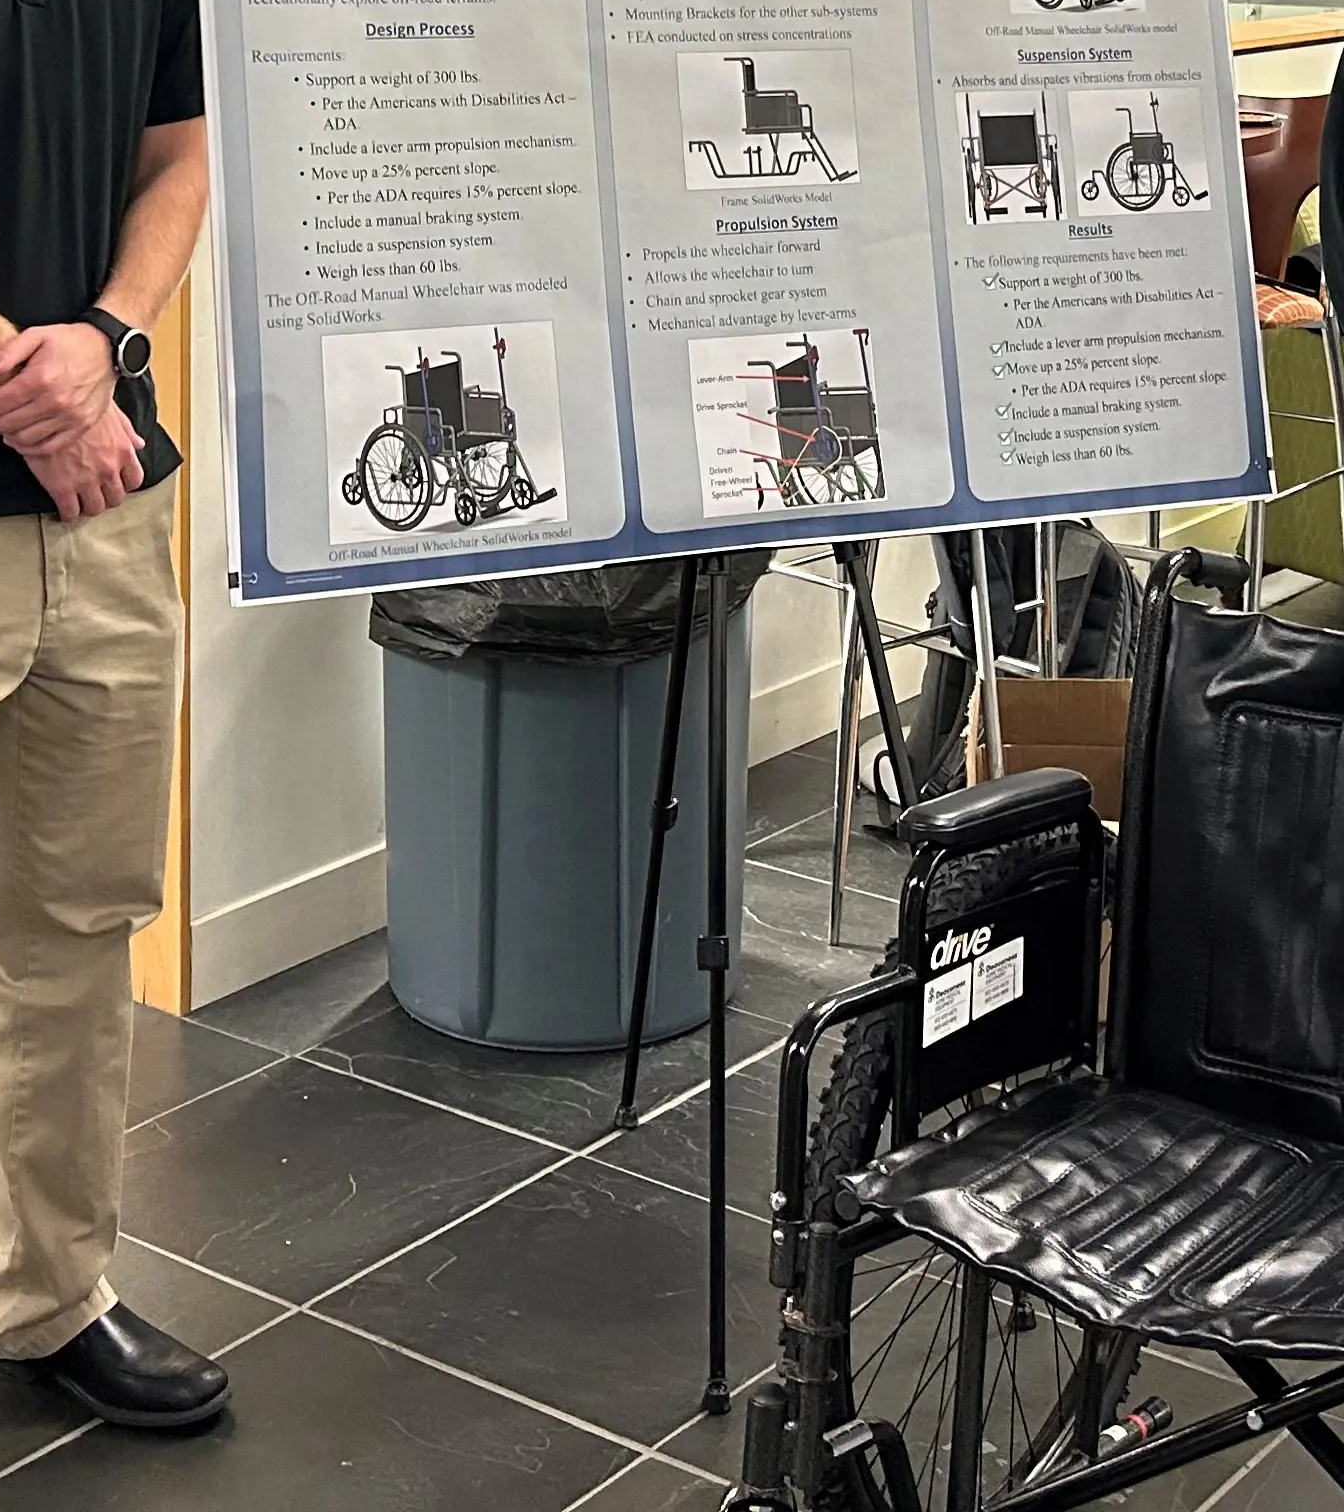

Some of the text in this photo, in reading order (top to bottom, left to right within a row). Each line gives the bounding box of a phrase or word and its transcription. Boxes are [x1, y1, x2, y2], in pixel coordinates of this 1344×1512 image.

[365, 22, 476, 39] Design Process
[1017, 47, 1132, 64] Suspension System
[305, 69, 483, 90] Support a weight of 300 lbs.
[322, 91, 567, 111] Per the Americans with Disabilities Act
[715, 215, 840, 234] Propulsion System
[1068, 222, 1113, 238] Results
[316, 258, 462, 282] Weigh less than 60 lbs.
[266, 308, 384, 331] using SolidWorks.
[1015, 443, 1133, 468] Weigh less than 60 lbs.
[931, 926, 992, 970] drive
